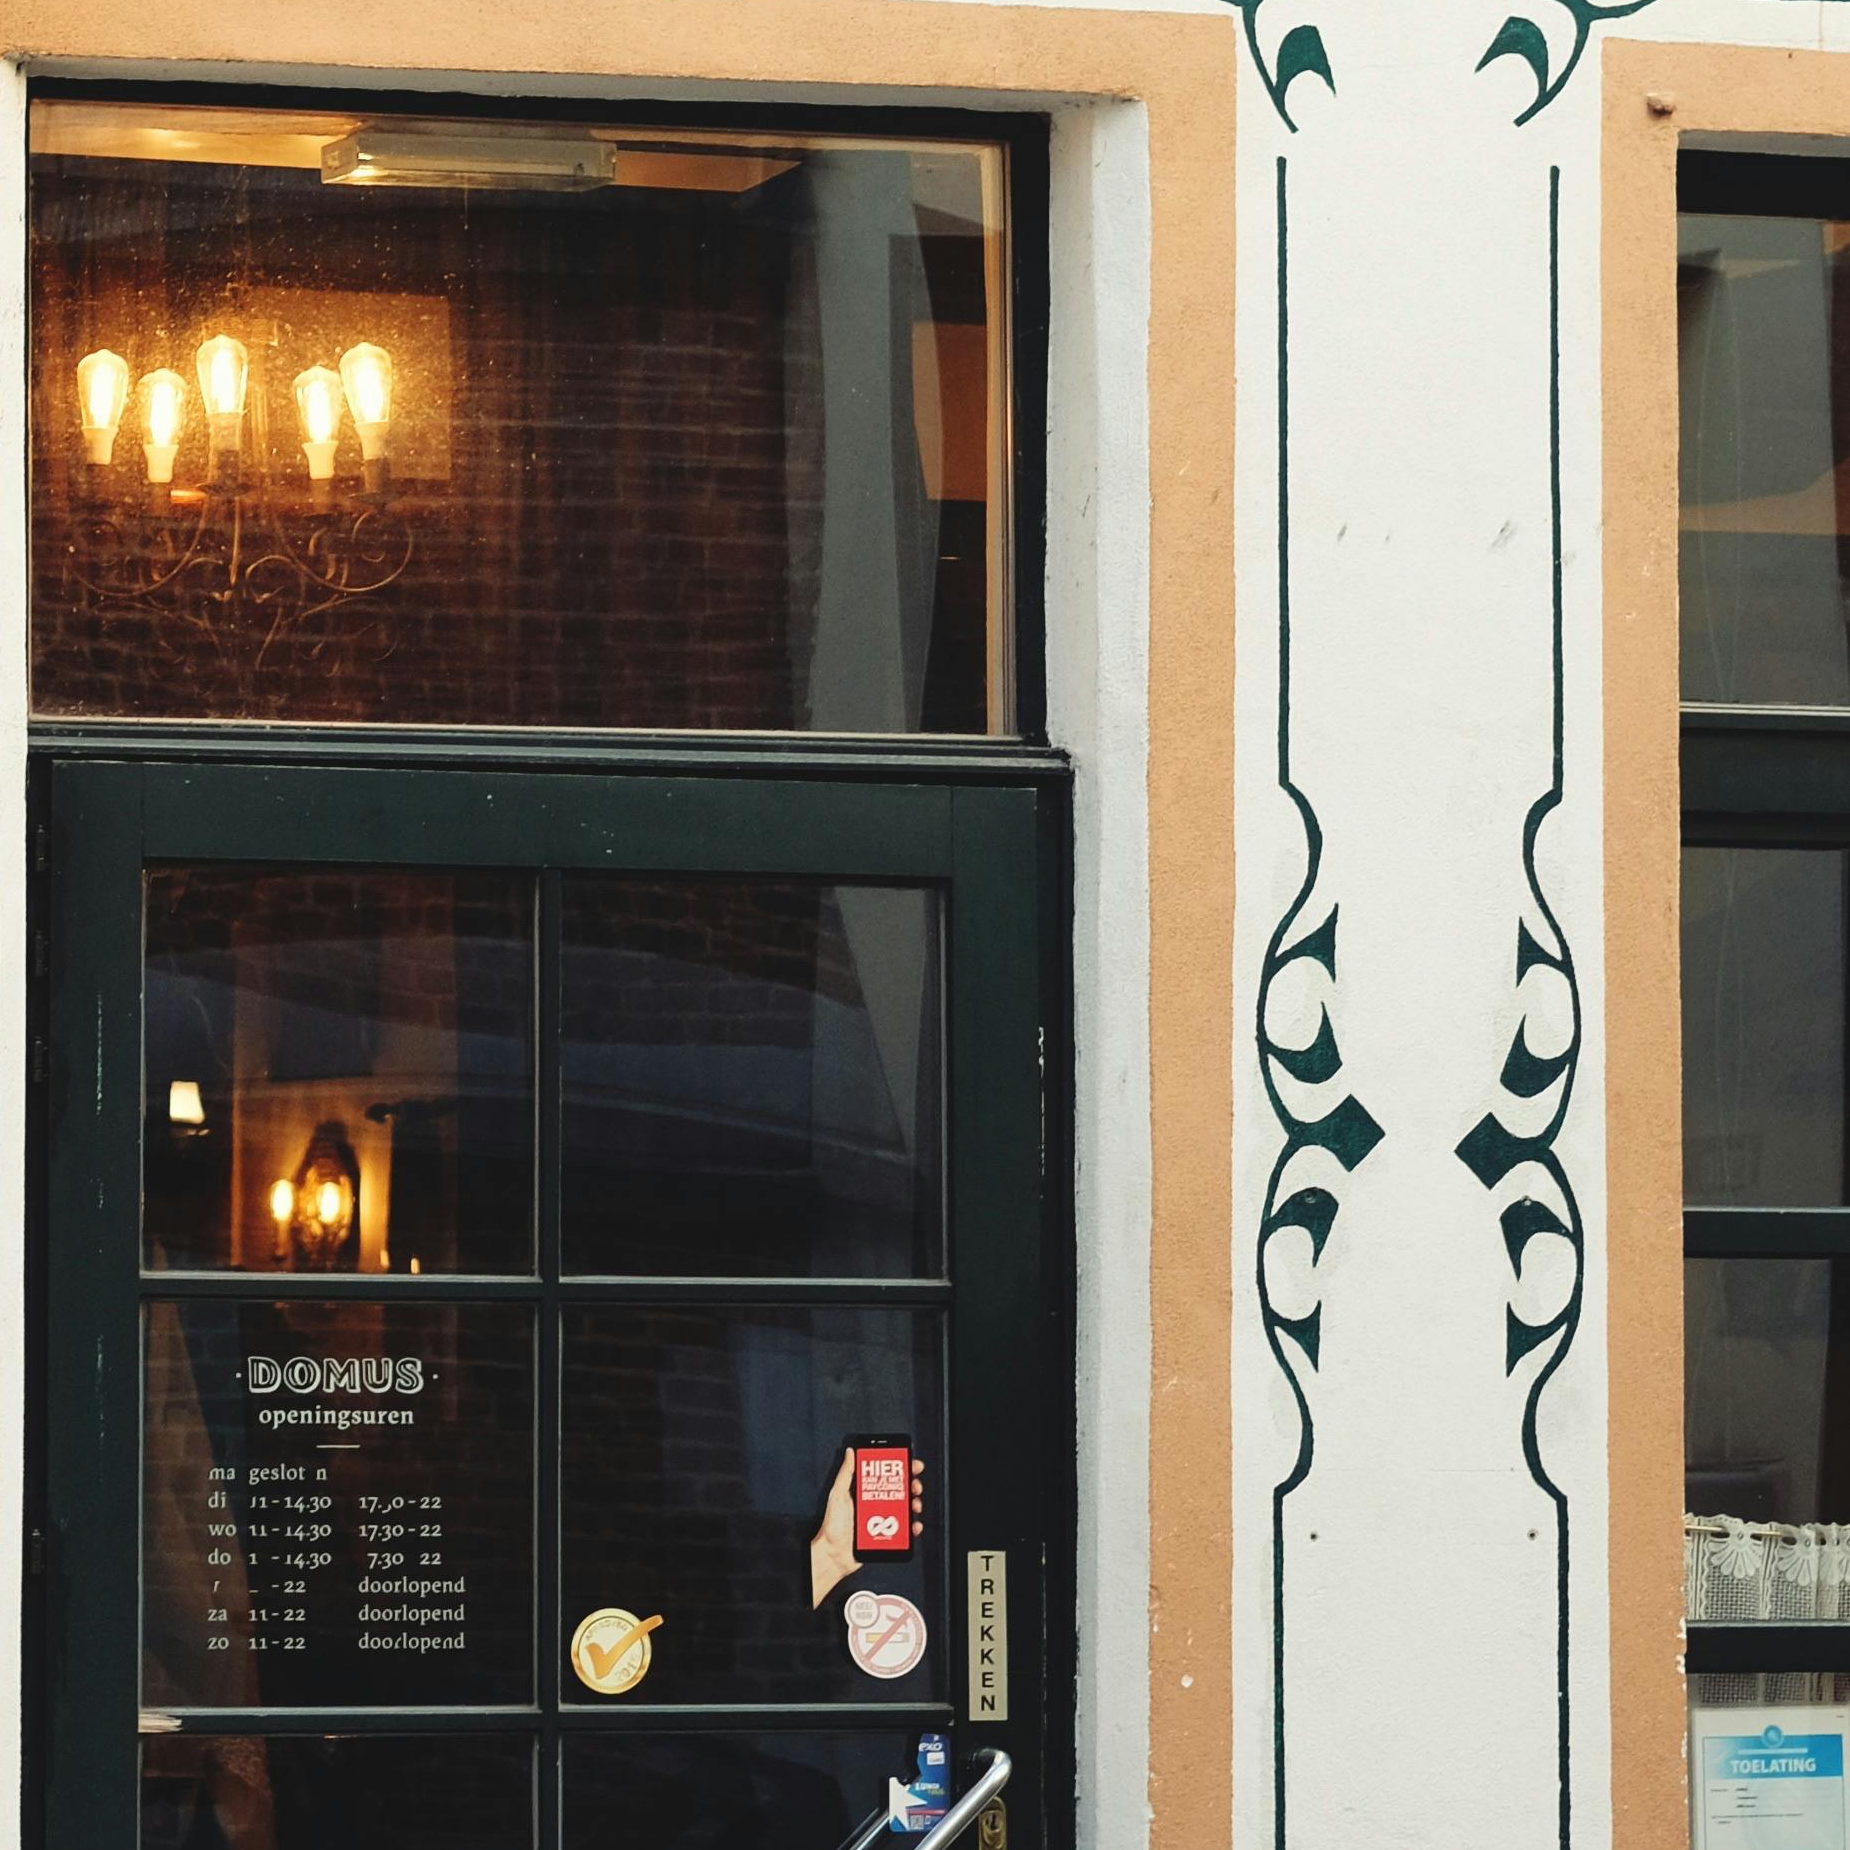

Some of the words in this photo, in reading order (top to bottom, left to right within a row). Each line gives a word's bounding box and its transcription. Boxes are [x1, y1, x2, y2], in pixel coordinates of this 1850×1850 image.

[247, 1356, 425, 1395] DOMUS
[258, 1404, 415, 1430] openingsuren
[208, 1467, 236, 1481] ma
[861, 1460, 904, 1477] HIER
[208, 1491, 227, 1509] di
[208, 1524, 237, 1536] wo
[208, 1548, 232, 1565] do
[358, 1576, 466, 1598] doorlopend
[208, 1609, 228, 1621] za
[358, 1604, 466, 1626] doorlopend
[208, 1637, 230, 1650] zo
[358, 1632, 466, 1654] doorlopend
[980, 1555, 996, 1712] TREKKEN
[1730, 1757, 1817, 1774] TOELATING
